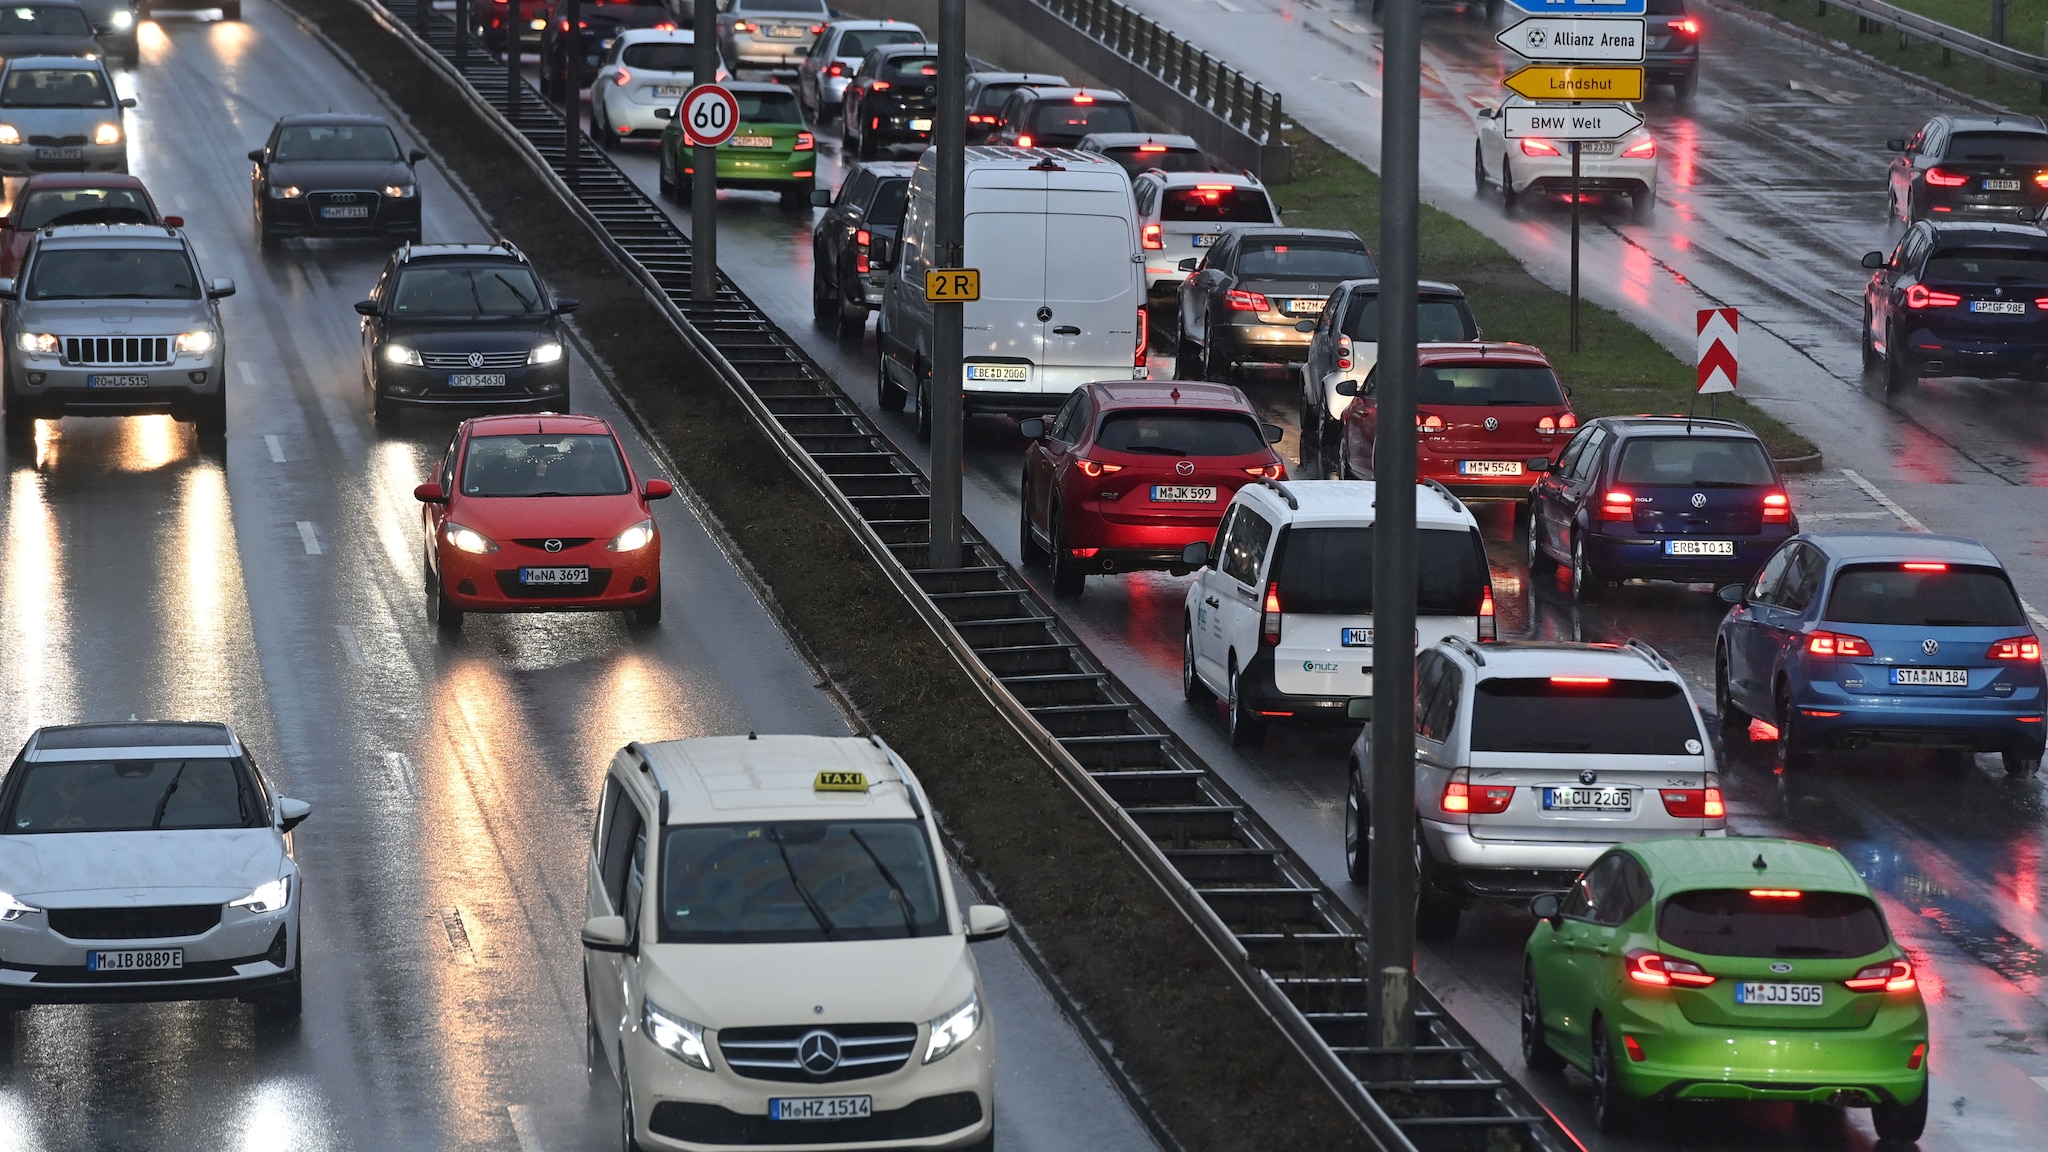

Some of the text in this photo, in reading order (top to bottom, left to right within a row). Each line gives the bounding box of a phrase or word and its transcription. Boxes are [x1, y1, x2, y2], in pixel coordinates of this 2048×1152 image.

[1554, 32, 1594, 47] Allianz
[1601, 32, 1635, 47] Arena
[1550, 78, 1612, 90] Landshut
[694, 102, 726, 129] 60
[1531, 117, 1601, 129] BMW Welt
[935, 275, 969, 296] 2 R
[1004, 368, 1025, 379] 2006
[129, 376, 147, 386] 515
[475, 375, 505, 386] 54630
[1492, 463, 1517, 473] 5543
[1190, 488, 1211, 499] 599
[1719, 543, 1732, 554] 13
[559, 569, 588, 581] 3691
[1946, 671, 1966, 685] 184
[823, 773, 861, 784] TAXI
[1594, 792, 1630, 807] 2205
[1791, 986, 1820, 1002] 505
[829, 1098, 869, 1115] 1514
